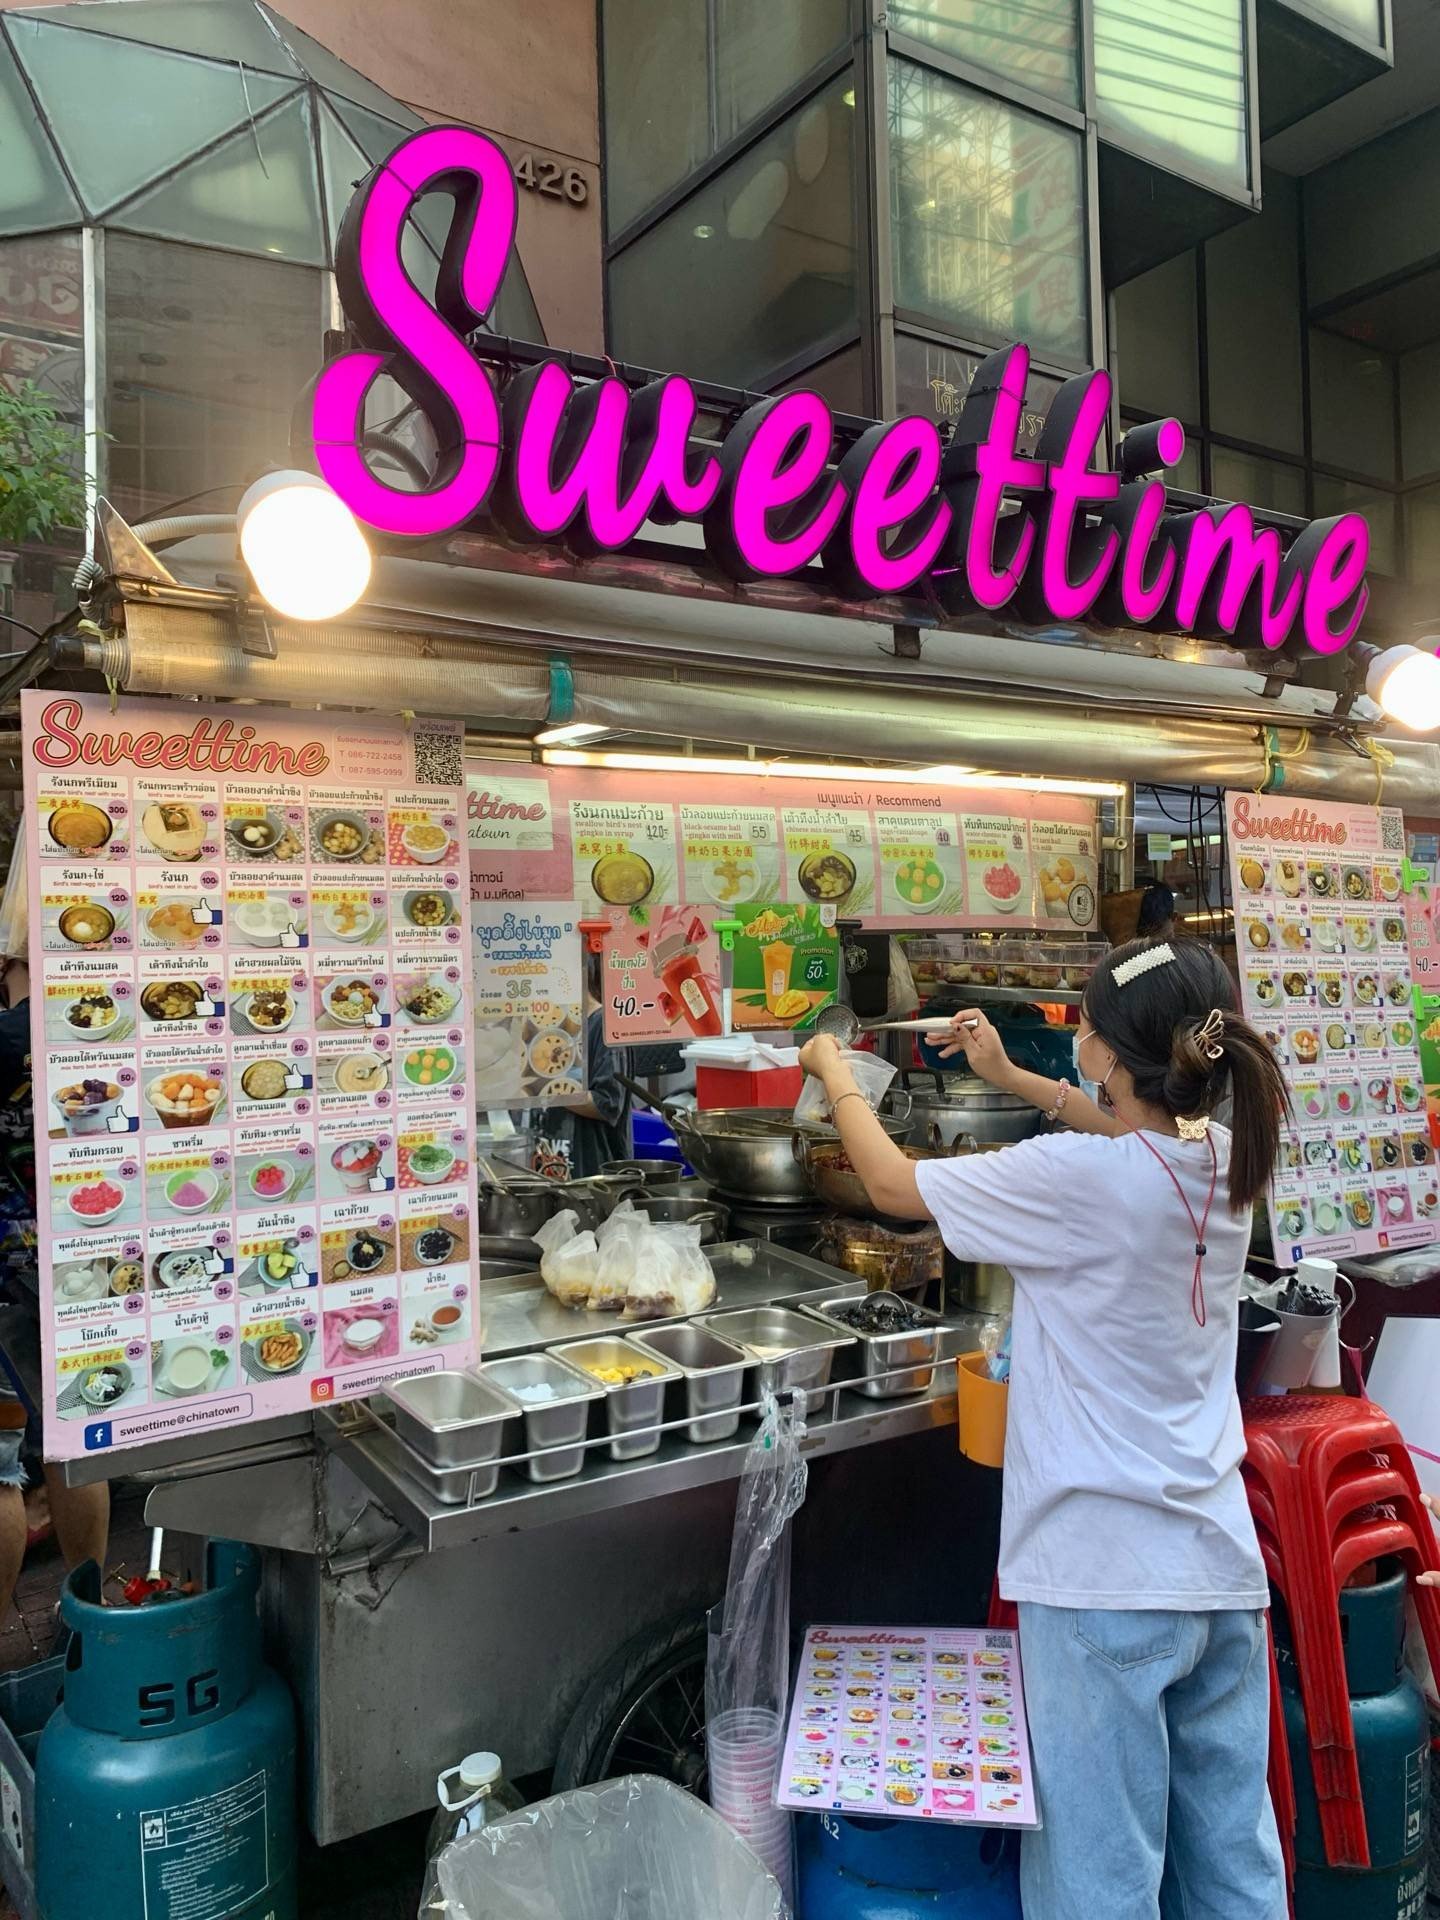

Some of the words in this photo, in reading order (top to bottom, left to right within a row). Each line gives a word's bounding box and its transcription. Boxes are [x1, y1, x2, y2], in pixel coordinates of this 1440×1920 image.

[514, 153, 587, 202] 426
[314, 125, 1369, 656] Sweettime
[33, 699, 329, 777] Sweettime
[876, 794, 942, 808] Recommend
[751, 821, 768, 834] 55
[1231, 796, 1348, 845] Sweettime
[161, 870, 189, 883] รังนก
[807, 965, 830, 979] 50.-
[1415, 957, 1439, 972] 40.-
[506, 979, 532, 999] 35
[504, 1002, 513, 1014] 3
[530, 1002, 550, 1013] 100
[612, 996, 655, 1017] 40.-
[342, 1363, 436, 1391] sweettimechinatown
[119, 1404, 240, 1437] sweettime@chinatown
[808, 1630, 927, 1645] Sweettime
[139, 1668, 220, 1728] SG
